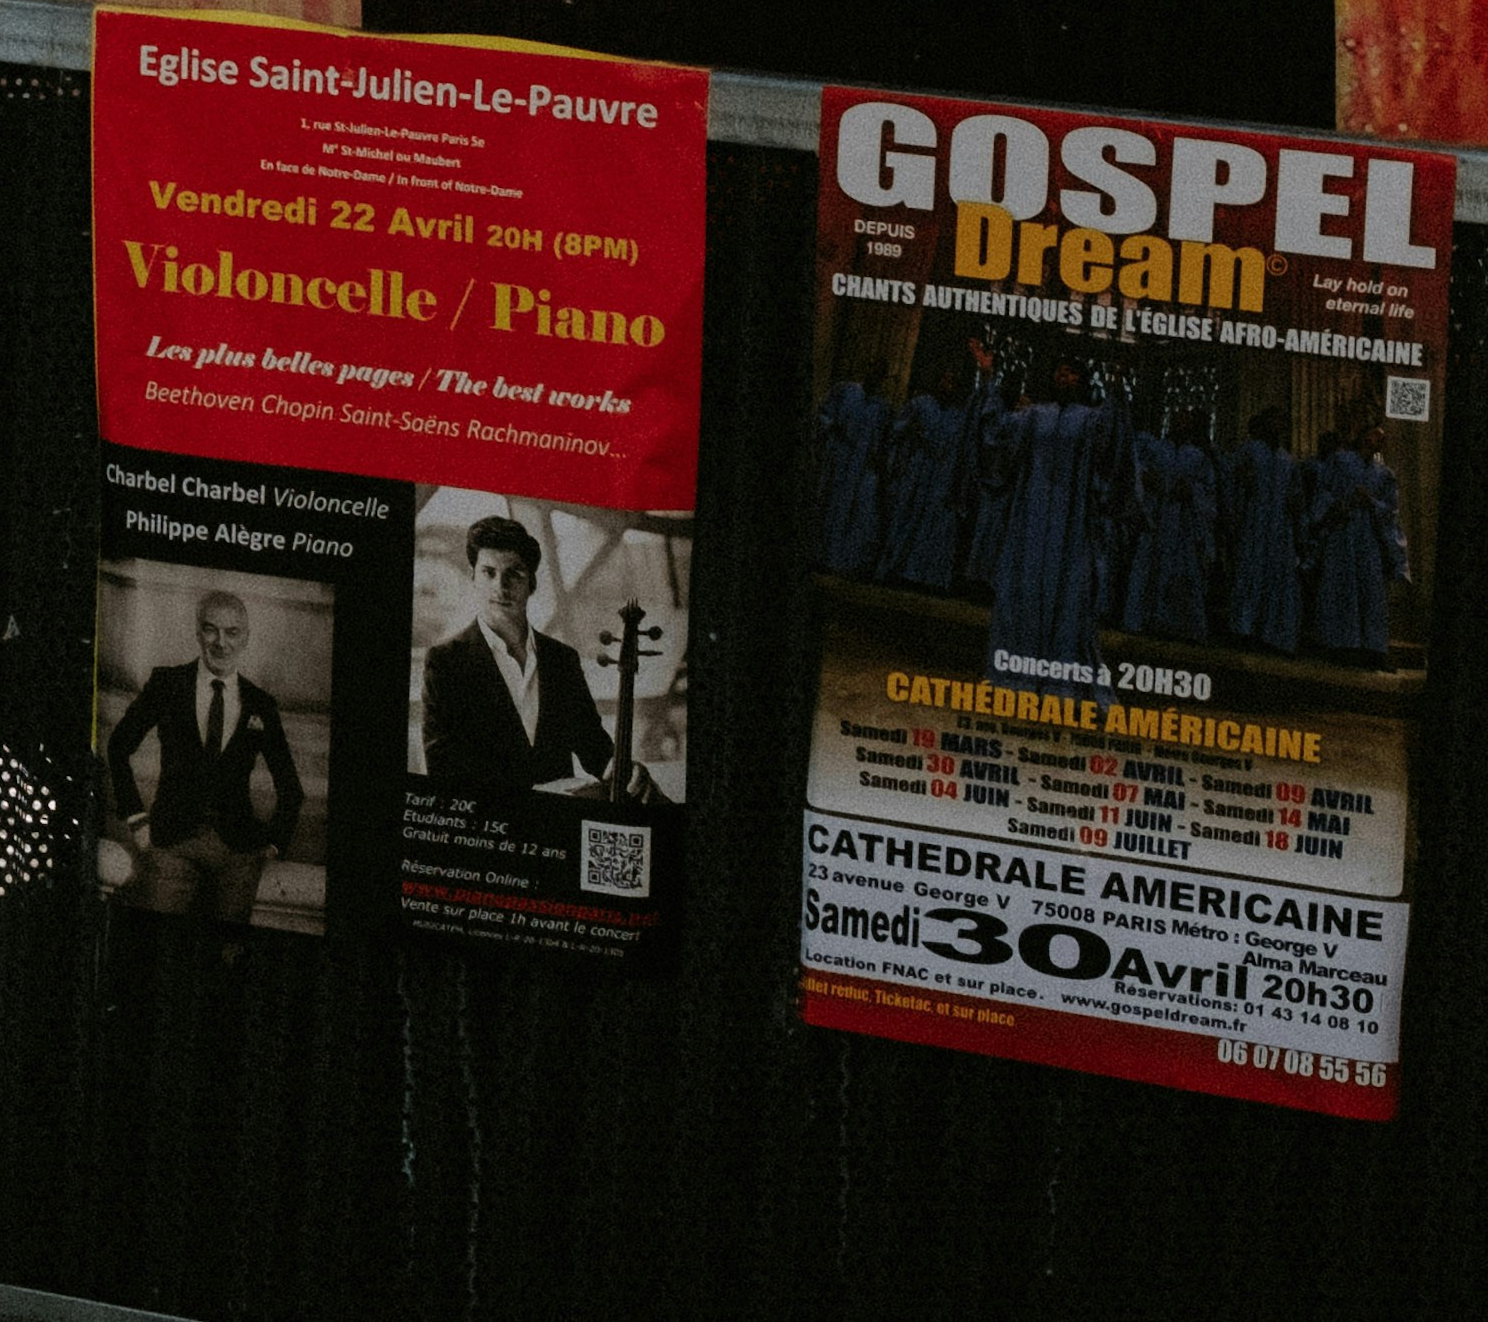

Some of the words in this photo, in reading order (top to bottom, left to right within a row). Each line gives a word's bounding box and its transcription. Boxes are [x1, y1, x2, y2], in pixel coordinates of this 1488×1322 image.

[138, 44, 239, 86] Eglise
[249, 56, 658, 128] Saint-Julien-Le-Pauvre
[149, 179, 317, 226] Vendredi
[330, 200, 375, 233] 22
[388, 207, 473, 243] Avril
[487, 224, 543, 252] 20H
[553, 231, 639, 266] (8PM)
[837, 101, 1436, 270] GOSPEL
[853, 219, 916, 241] DEPUIS
[865, 240, 902, 259] 1989
[121, 240, 437, 321] Violoncelle
[449, 278, 475, 332] /
[489, 281, 666, 348] Piano
[831, 271, 917, 307] CHANTS
[921, 284, 1084, 327] AUTHENTIQUES
[1090, 306, 1118, 331] DE
[1124, 305, 1213, 343] L'ÉGLISE
[1219, 319, 1424, 369] AFRO-AMÉRICAINE
[145, 381, 255, 411] Beethoven
[262, 394, 335, 423] Chopin
[339, 402, 460, 438] Saint-Saëns
[106, 462, 176, 494] Charbel
[181, 474, 267, 505] Charbel
[272, 484, 391, 521] Violoncelle
[125, 509, 209, 544] Philippe
[214, 520, 287, 555] Alègre
[292, 531, 354, 558] Piano
[994, 648, 1093, 685] Concerts
[1096, 662, 1112, 687] à
[1117, 662, 1212, 702] 20H30
[886, 670, 1098, 733] CATHÉDRALE
[1107, 707, 1323, 765] AMÉRICAINE
[808, 824, 1087, 896] CATHEDRALE
[1100, 871, 1384, 942] AMERICAINE
[804, 887, 920, 948] Samedi
[921, 907, 1111, 980] 30
[1110, 947, 1249, 1000] Avril
[1261, 973, 1374, 1015] 20h30
[1061, 992, 1248, 1034] www.gospeldream.fr
